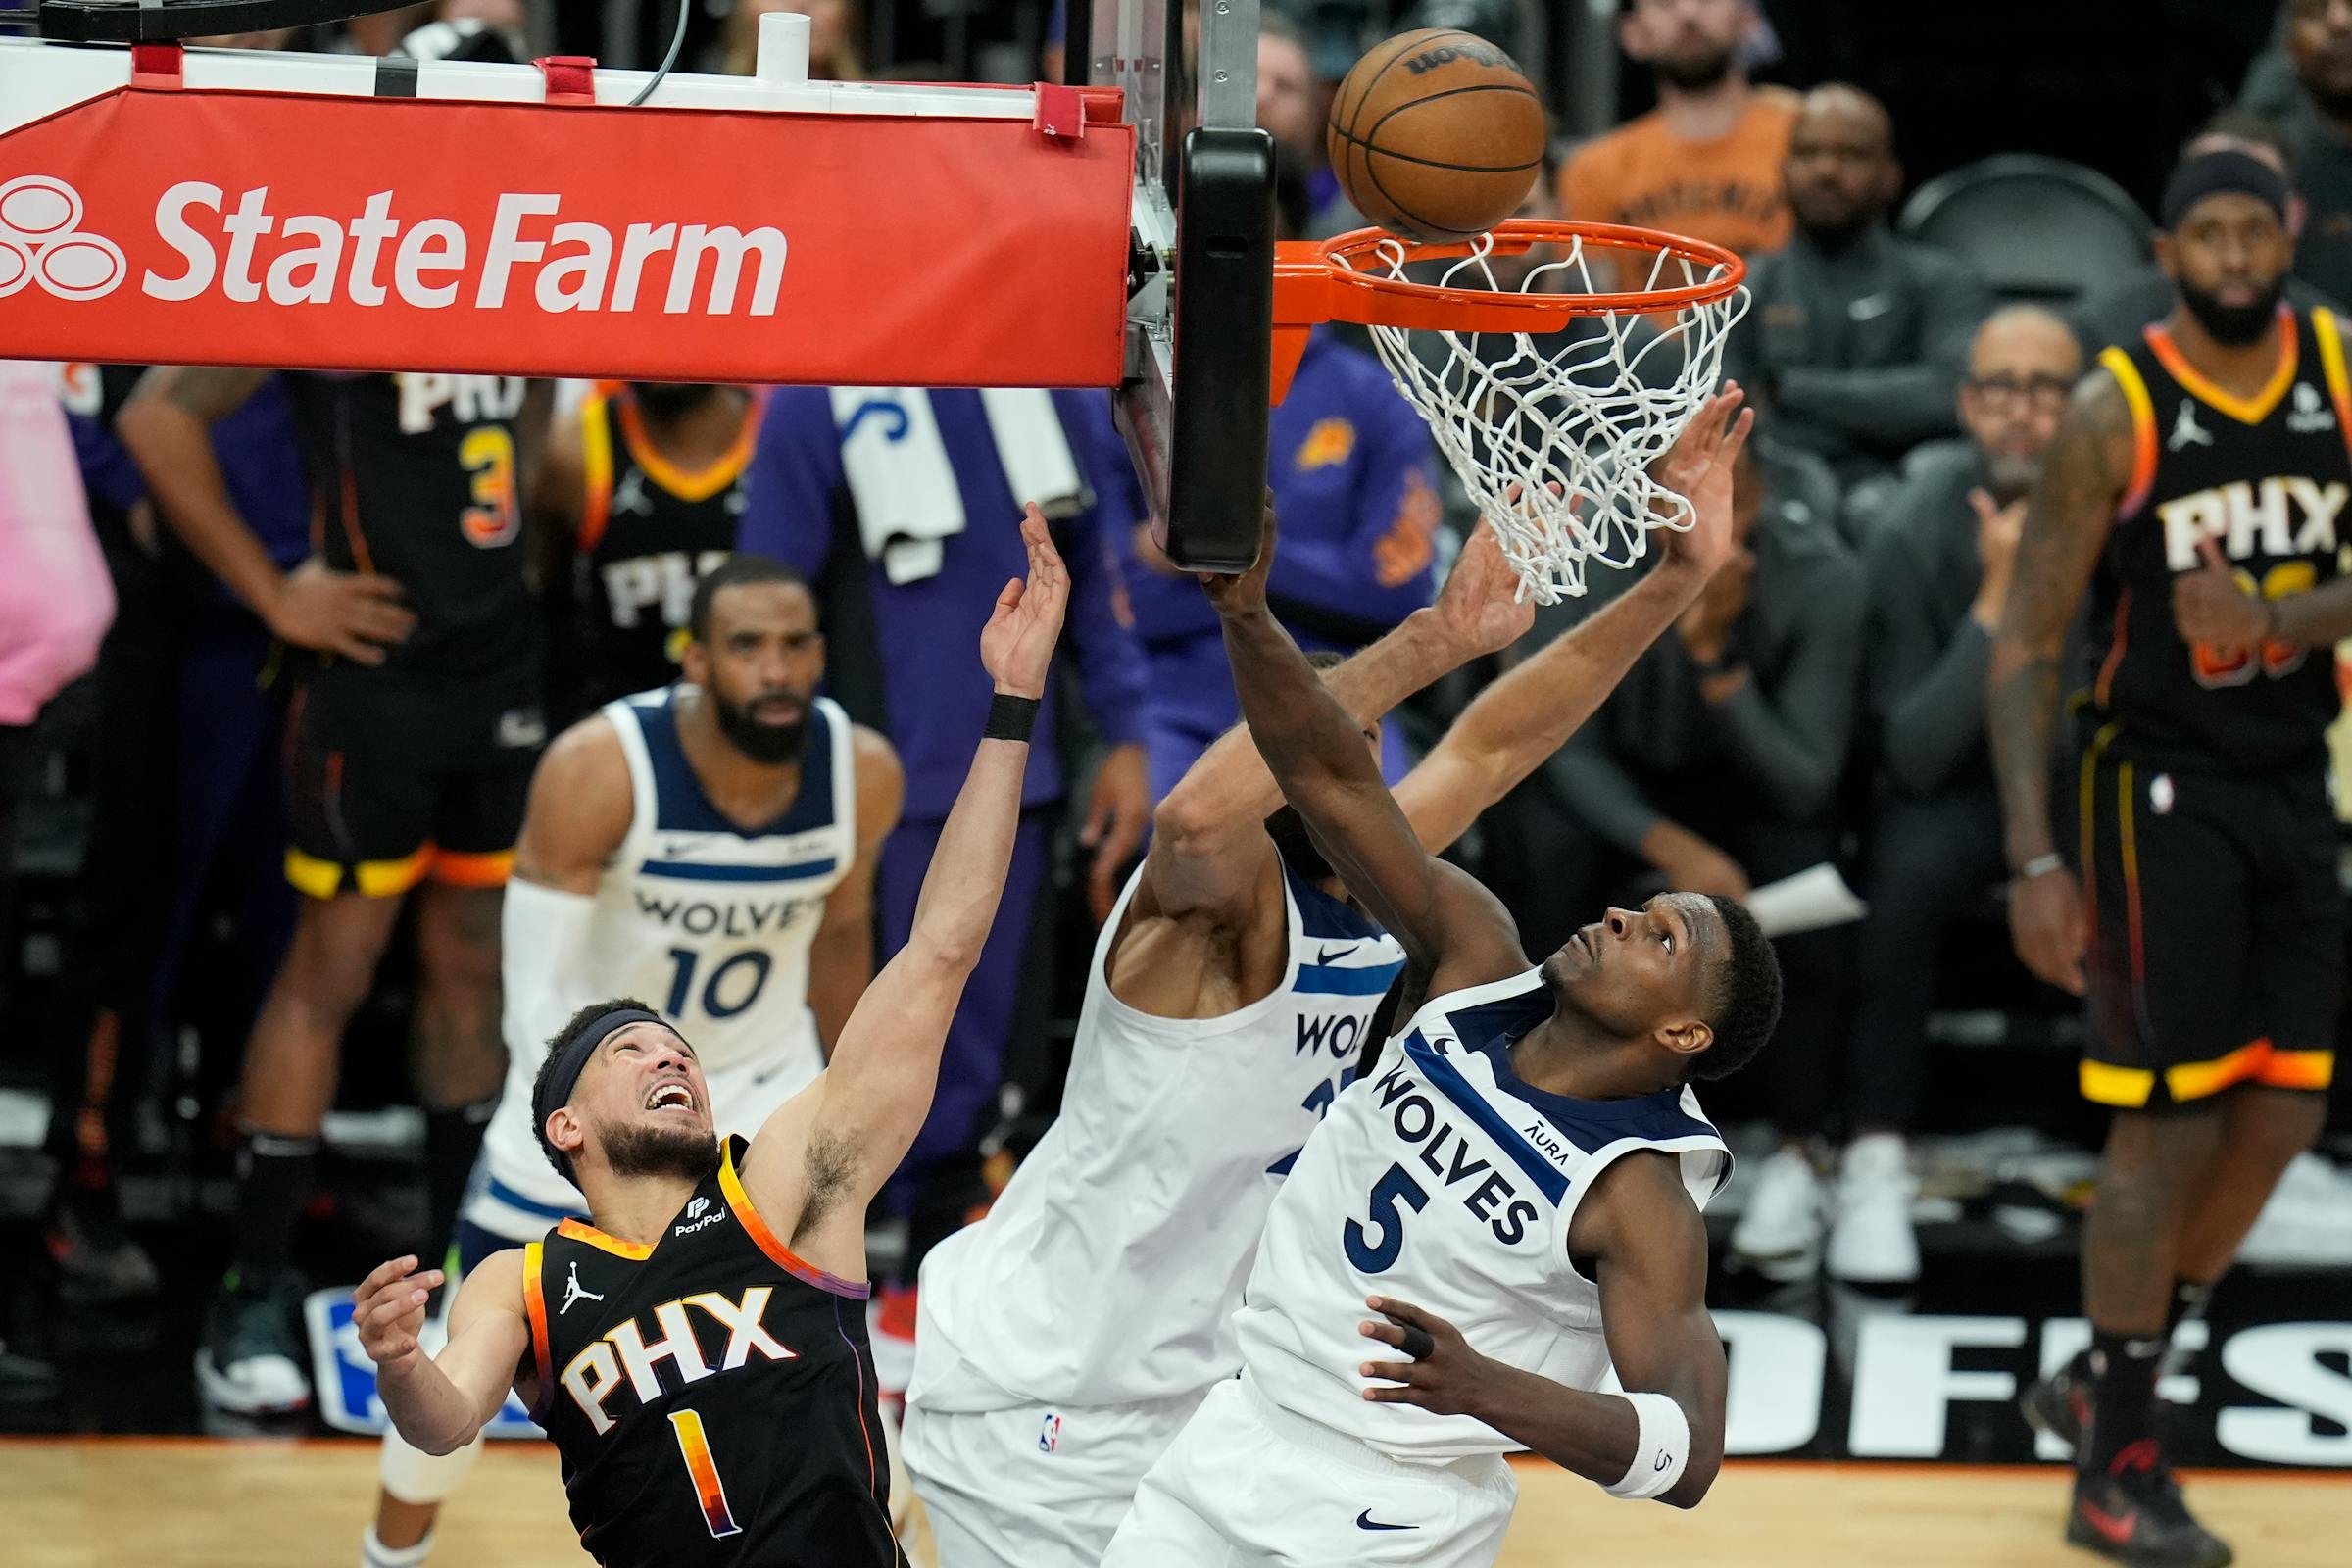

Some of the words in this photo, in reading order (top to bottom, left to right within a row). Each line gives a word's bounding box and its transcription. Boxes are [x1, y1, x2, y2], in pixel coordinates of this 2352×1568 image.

[458, 424, 521, 549] 3
[2156, 475, 2350, 571] PHX
[665, 948, 772, 1019] 10
[1372, 1055, 1539, 1245] WOLVES
[675, 1207, 725, 1237] PayPal
[1344, 1160, 1430, 1274] 5
[560, 1286, 800, 1437] PHX
[667, 1408, 742, 1538] 1
[1654, 1448, 1673, 1472] 5
